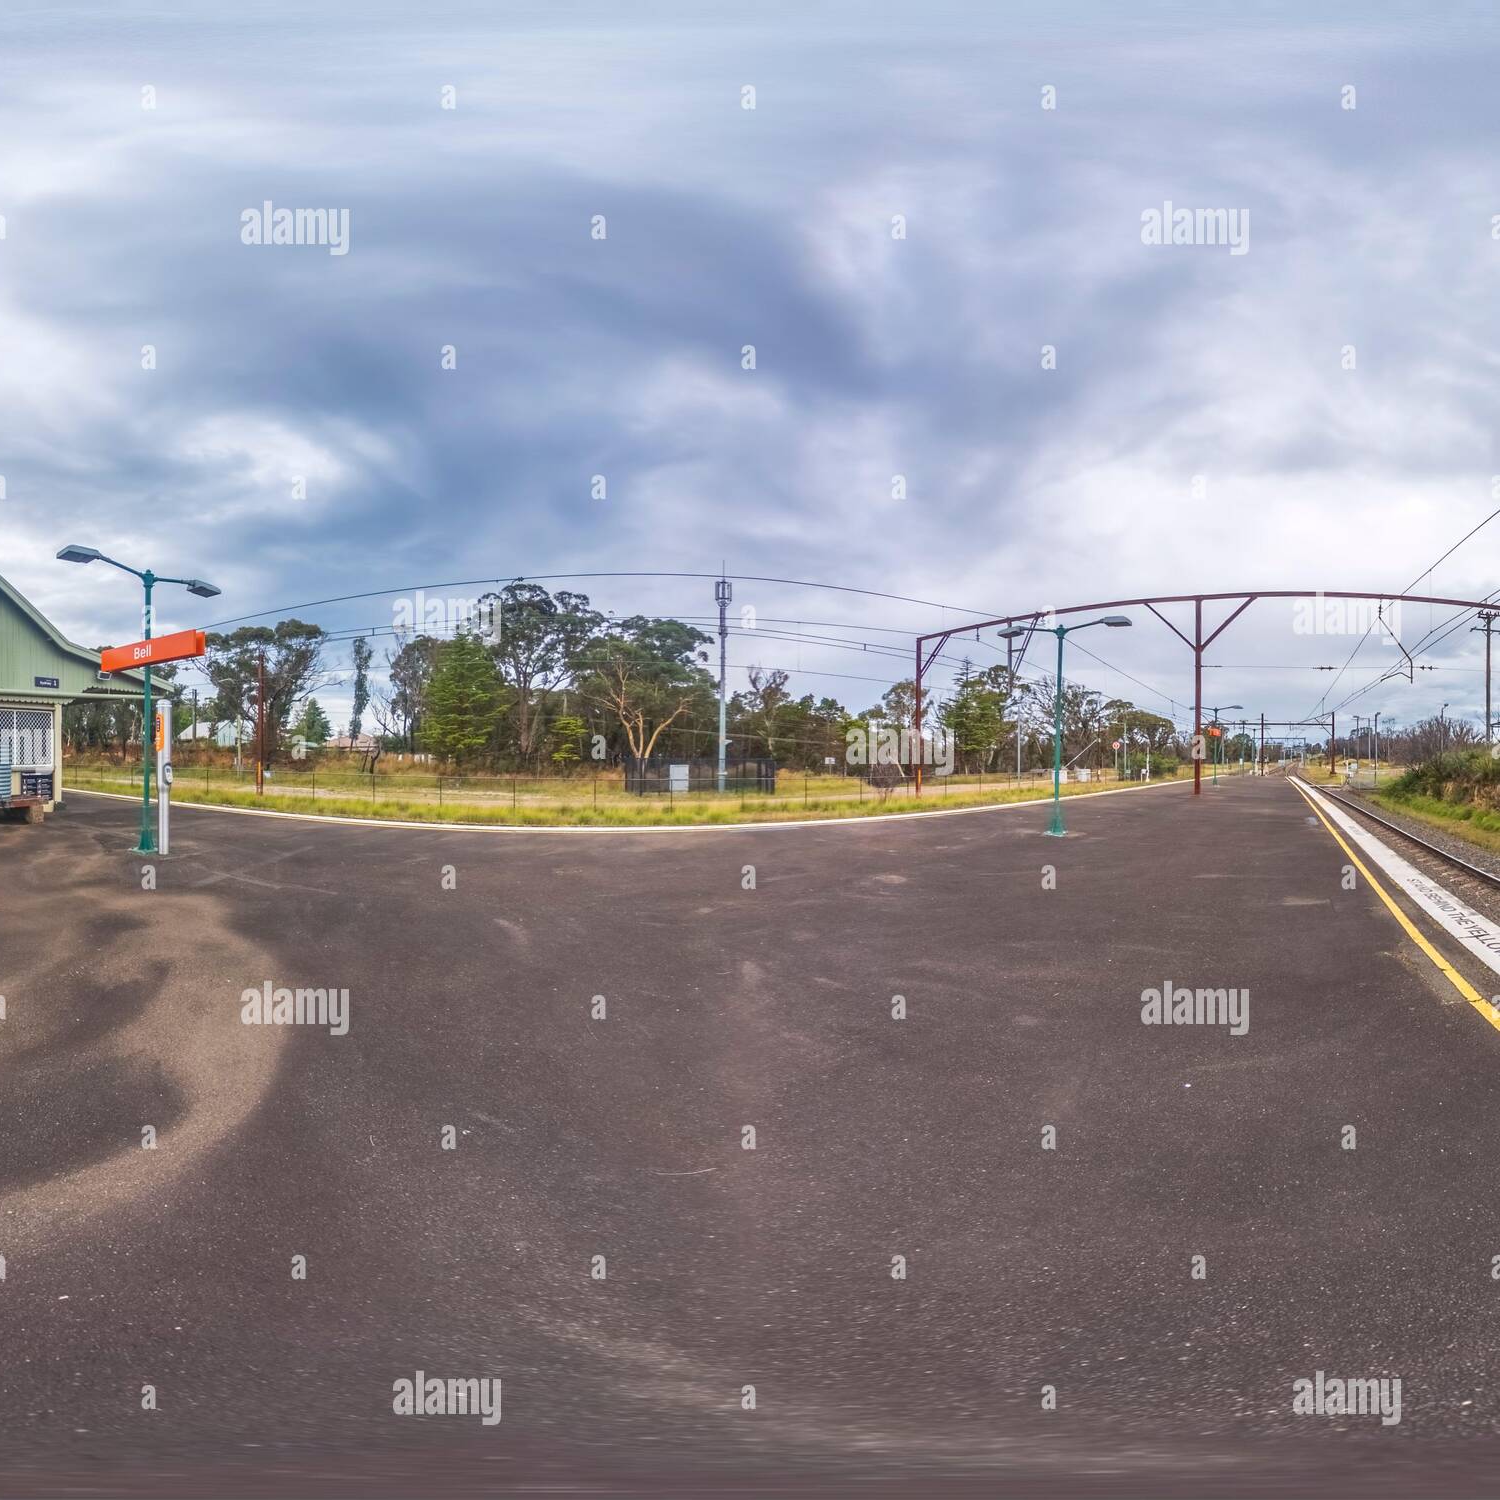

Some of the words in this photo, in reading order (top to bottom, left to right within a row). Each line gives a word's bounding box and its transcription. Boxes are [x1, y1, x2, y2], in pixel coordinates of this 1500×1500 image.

[133, 643, 152, 660] Bell
[1448, 912, 1476, 926] THE
[1464, 924, 1500, 957] YELLO
